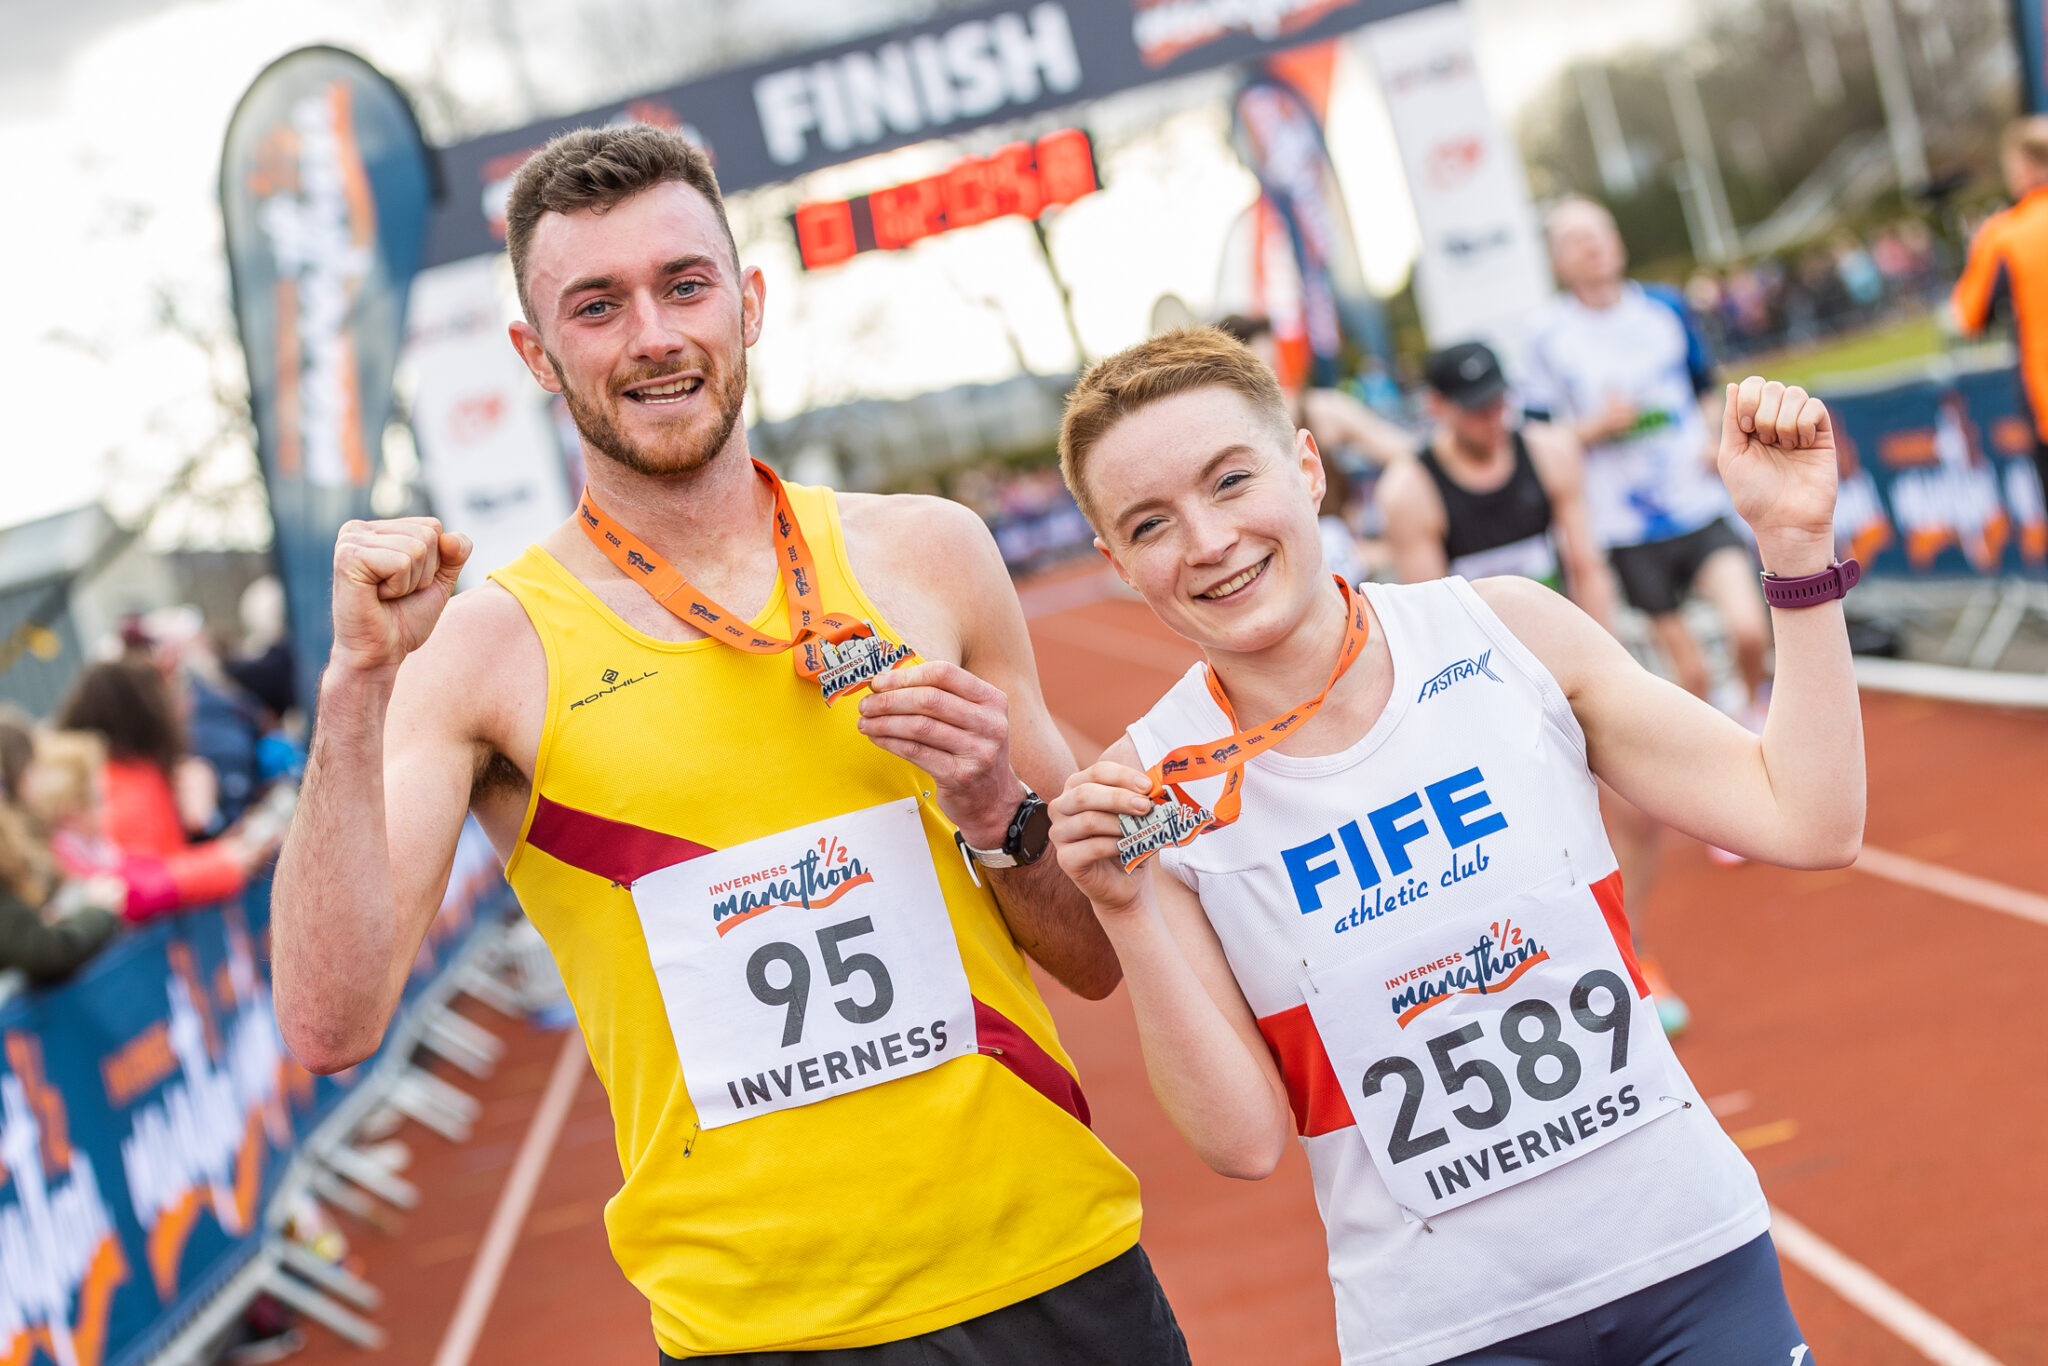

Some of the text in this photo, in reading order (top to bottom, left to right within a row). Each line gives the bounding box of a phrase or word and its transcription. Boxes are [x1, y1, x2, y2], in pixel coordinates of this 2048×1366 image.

[753, 1, 1082, 166] FINISH
[570, 671, 659, 710] RONHILL
[821, 657, 864, 682] INVERNESS
[822, 643, 913, 698] marathon
[1120, 823, 1162, 849] INVERNESS
[1120, 808, 1211, 864] marathon
[1280, 766, 1509, 915] FIFE
[709, 864, 788, 896] INVERNESS
[713, 849, 869, 922] marathon
[1334, 844, 1489, 934] athletic club
[746, 915, 895, 1049] 95
[1385, 952, 1463, 991] INVERNESS
[1391, 934, 1544, 1015] marathon
[727, 1020, 948, 1110] INVERNESS
[1362, 969, 1631, 1165] 2589
[1424, 1084, 1641, 1201] INVERNESS
